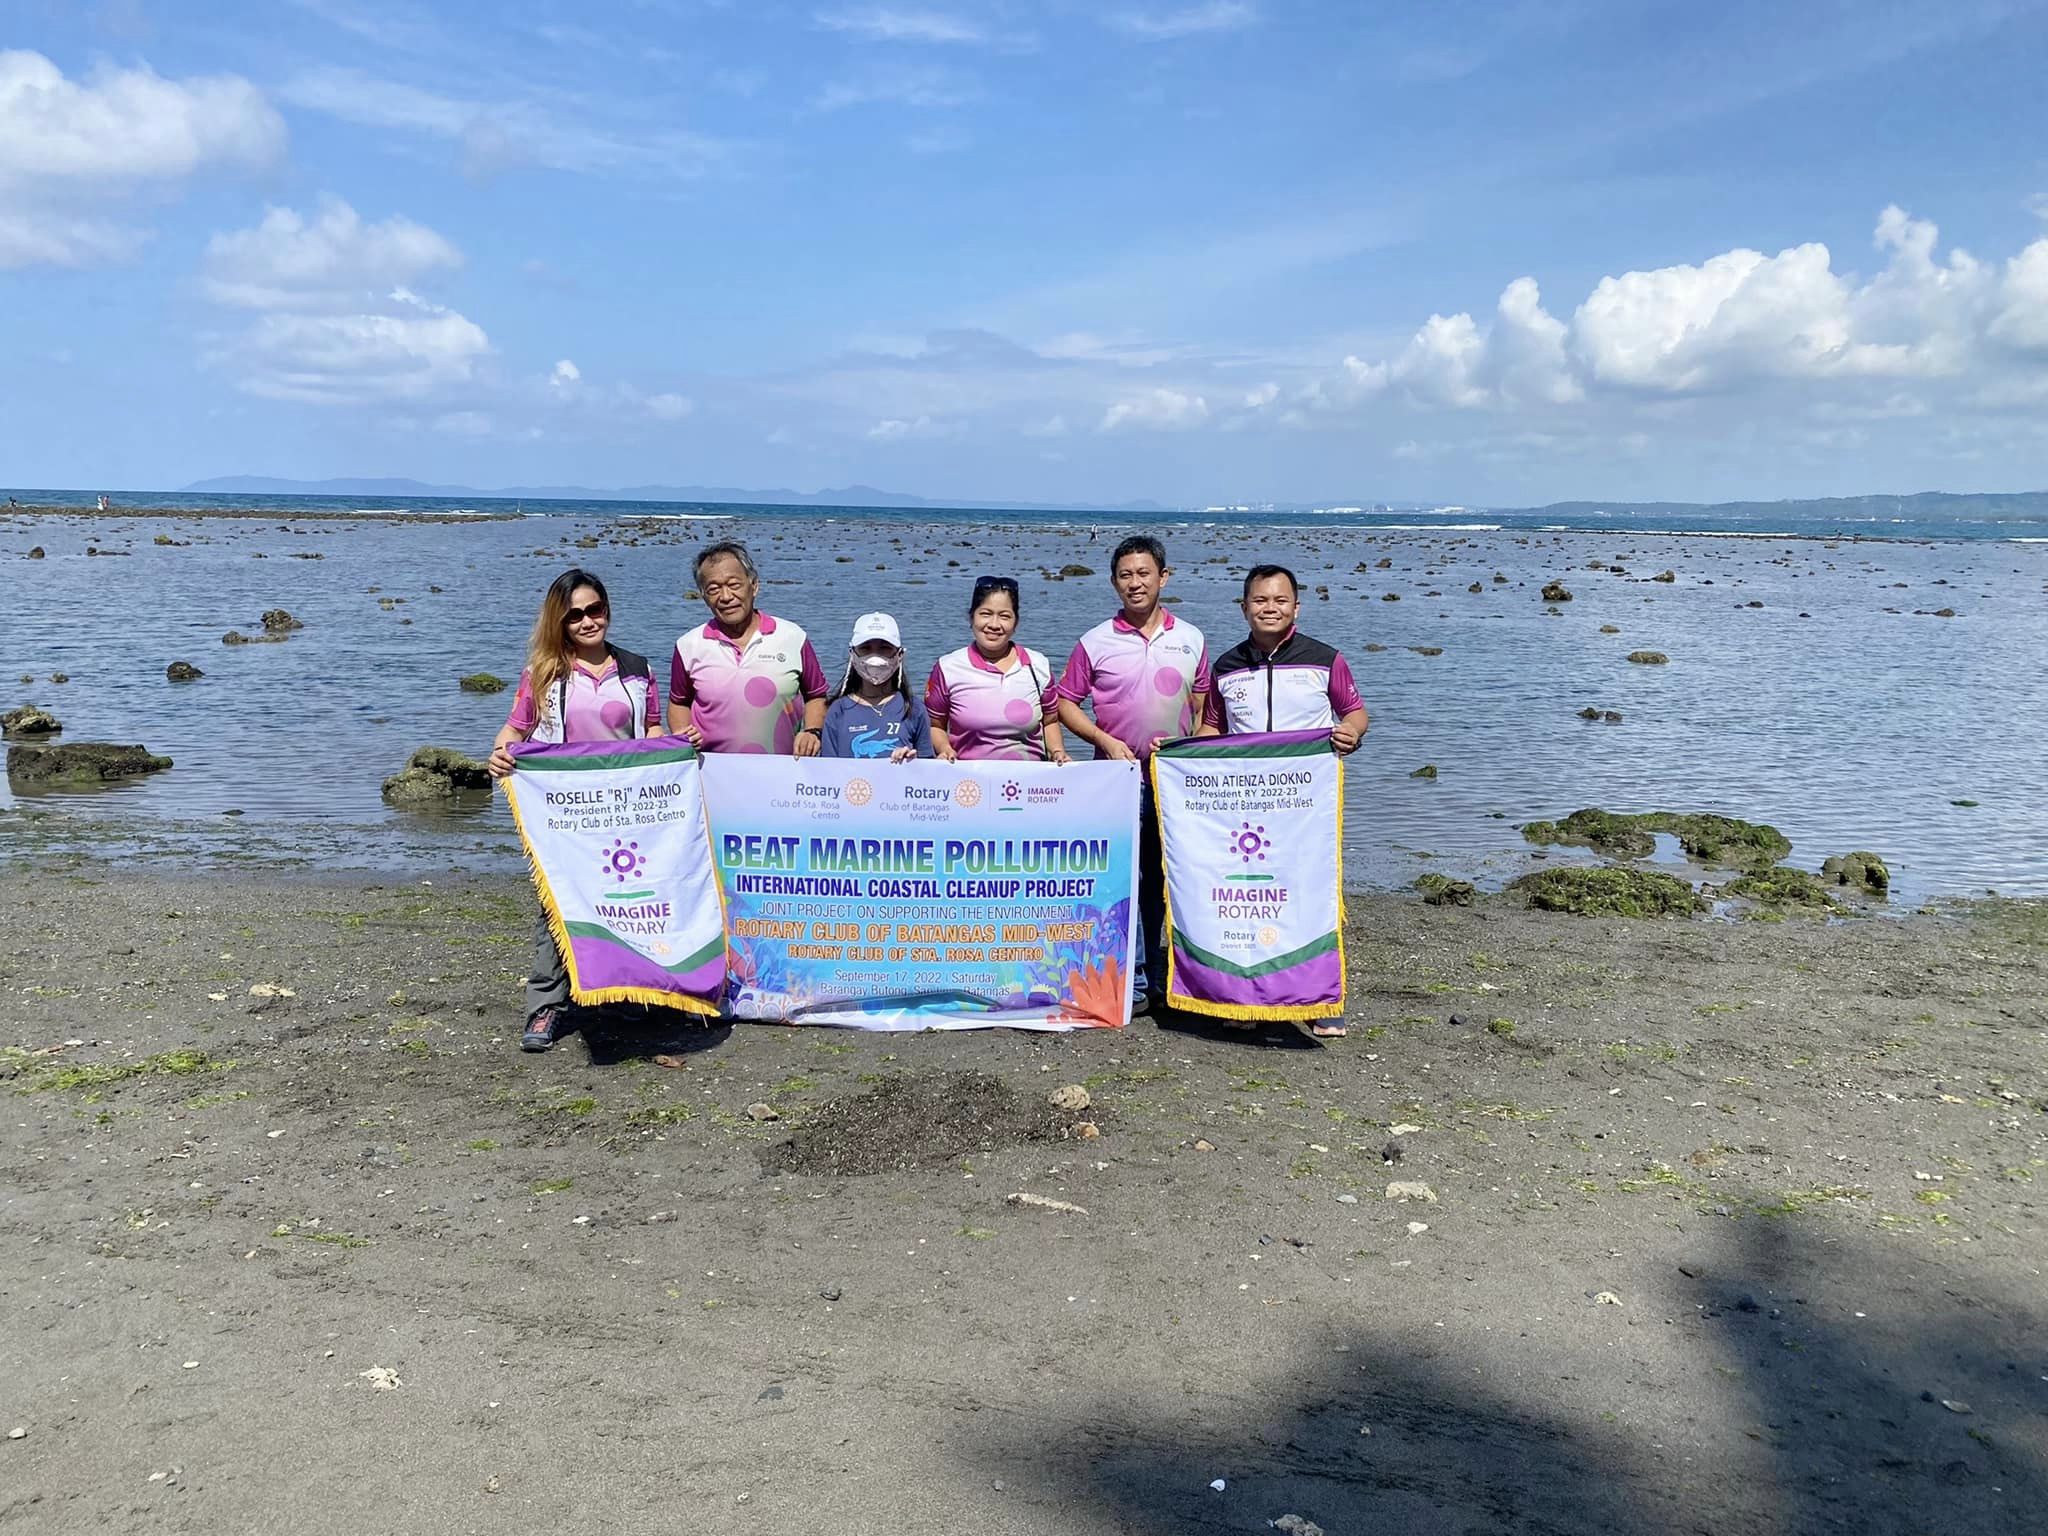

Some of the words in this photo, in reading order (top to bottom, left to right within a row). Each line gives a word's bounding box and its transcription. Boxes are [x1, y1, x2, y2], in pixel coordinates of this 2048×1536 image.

[887, 722, 901, 735] 27
[1185, 774, 1219, 788] EDSON
[1222, 774, 1266, 787] ATIENZA
[1269, 772, 1312, 785] DIOKNO
[546, 789, 604, 805] ROSELLE
[608, 787, 633, 804] "Rj"
[638, 783, 682, 799] ANIMO
[795, 783, 841, 800] Rotary
[905, 786, 950, 802] Rotary
[1027, 787, 1064, 795] IMAGINE
[1199, 789, 1242, 798] President
[1245, 789, 1257, 798] RY
[1261, 787, 1298, 797] 2022-23
[563, 805, 612, 816] President
[614, 803, 628, 814] RY
[632, 799, 669, 811] 2022-23
[770, 799, 790, 809] Club
[792, 798, 802, 809] of
[803, 799, 818, 809] Sta.
[821, 800, 840, 810] Rosa
[879, 801, 899, 811] Club
[901, 801, 912, 811] of
[912, 803, 950, 813] Batangas
[1027, 795, 1059, 804] ROTARY
[1185, 800, 1210, 812] Rotary
[1212, 800, 1228, 811] Club
[1230, 799, 1239, 810] of
[1240, 799, 1275, 812] Batangas
[1276, 797, 1313, 809] Mid-West
[547, 817, 578, 832] Rotary
[581, 815, 600, 829] Club
[603, 815, 613, 828] of
[615, 814, 633, 827] Sta.
[635, 813, 656, 826] Rosa
[657, 809, 686, 823] Centro
[811, 810, 840, 820] Centro
[910, 813, 949, 822] Mid-West
[723, 834, 799, 870] BEAT
[809, 837, 934, 874] MARINE
[944, 839, 1108, 874] POLLUTION
[736, 874, 862, 897] INTERNATIONAL
[867, 879, 940, 899] COASTAL
[946, 880, 1020, 899] CLEANUP
[1025, 878, 1095, 898] PROJECT
[1212, 888, 1288, 902] IMAGINE
[595, 903, 671, 919] IMAGINE
[759, 902, 792, 916] JOINT
[797, 903, 852, 918] PROJECT
[857, 905, 875, 919] ON
[879, 905, 957, 920] SUPPORTING
[962, 905, 983, 919] THE
[987, 905, 1072, 919] ENVIRONMENT
[1218, 905, 1282, 919] ROTARY
[607, 919, 666, 935] ROTARY
[735, 918, 806, 939] ROTARY
[812, 921, 859, 941] CLUB
[866, 923, 891, 942] OF
[896, 923, 996, 943] BATANGAS
[1002, 922, 1095, 942] MID-WEST
[1224, 931, 1256, 941] Rotary
[788, 944, 842, 960] ROTARY
[847, 946, 883, 960] CLUB
[888, 946, 906, 961] OF
[911, 947, 941, 961] STA.
[945, 947, 984, 961] ROSA
[988, 947, 1044, 961] CENTRO
[834, 969, 890, 983] September
[914, 972, 941, 983] 2022
[951, 972, 996, 985] Saturday
[820, 983, 867, 996] Barangay
